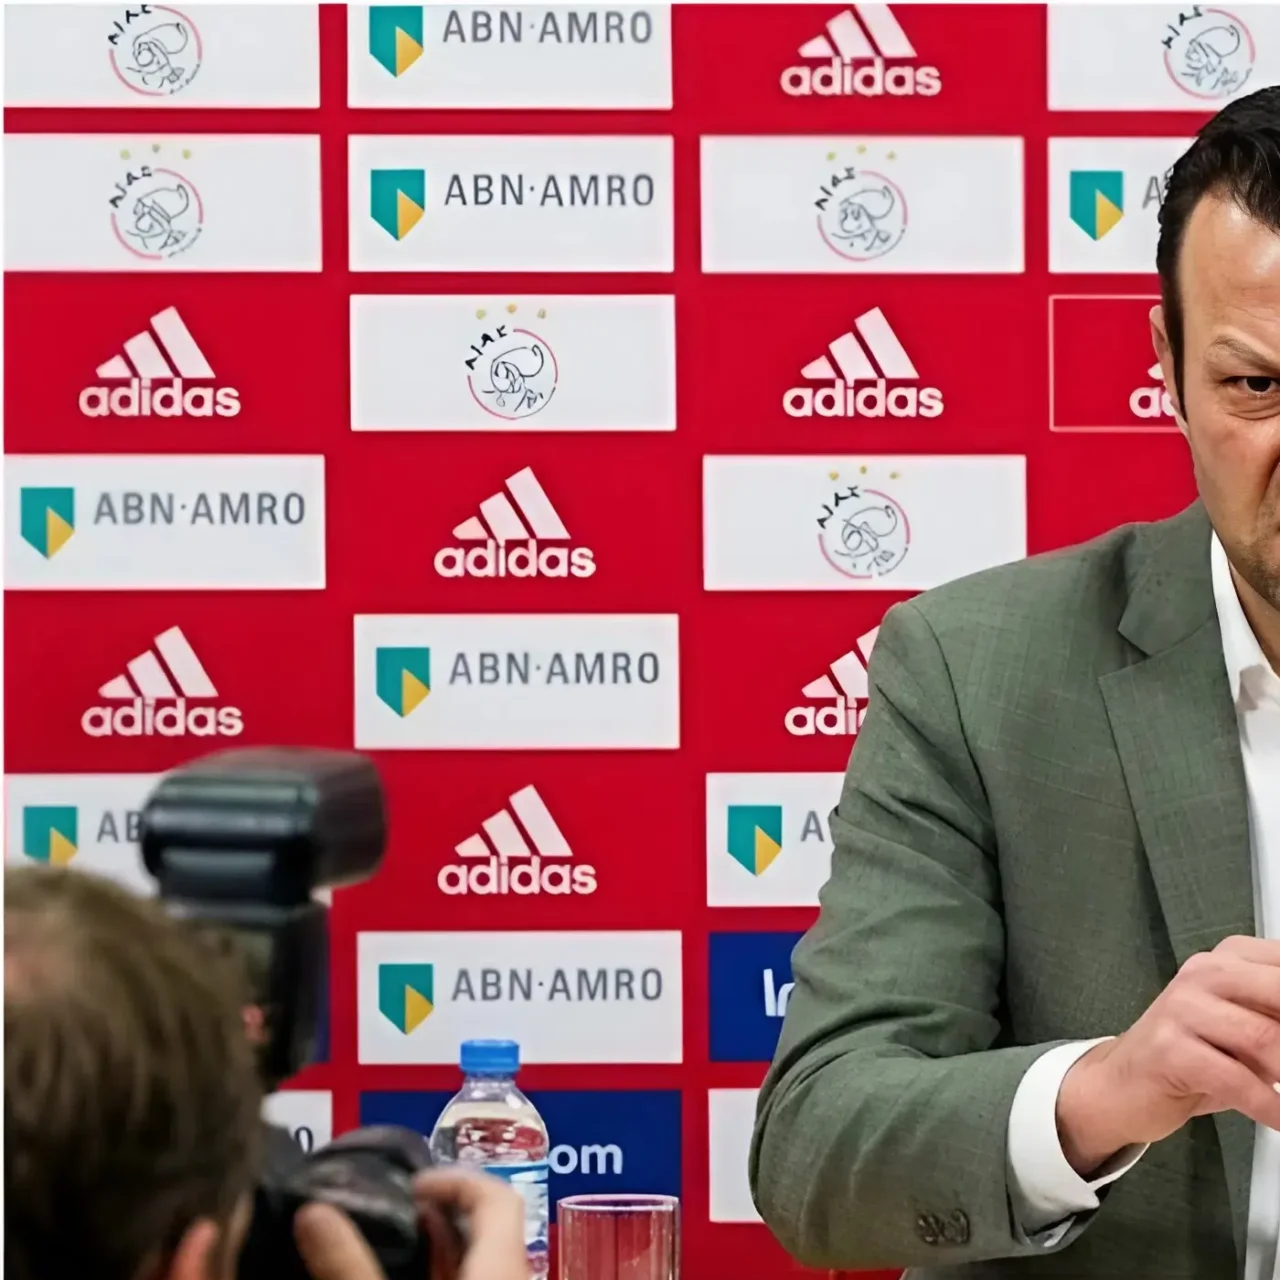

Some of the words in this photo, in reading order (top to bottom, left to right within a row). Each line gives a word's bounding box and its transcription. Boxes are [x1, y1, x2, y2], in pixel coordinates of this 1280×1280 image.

[780, 57, 942, 97] adidas
[78, 378, 241, 417] adidas
[782, 379, 944, 418] adidas
[433, 539, 597, 578] adidas
[81, 698, 244, 737] adidas
[437, 856, 598, 895] adidas
